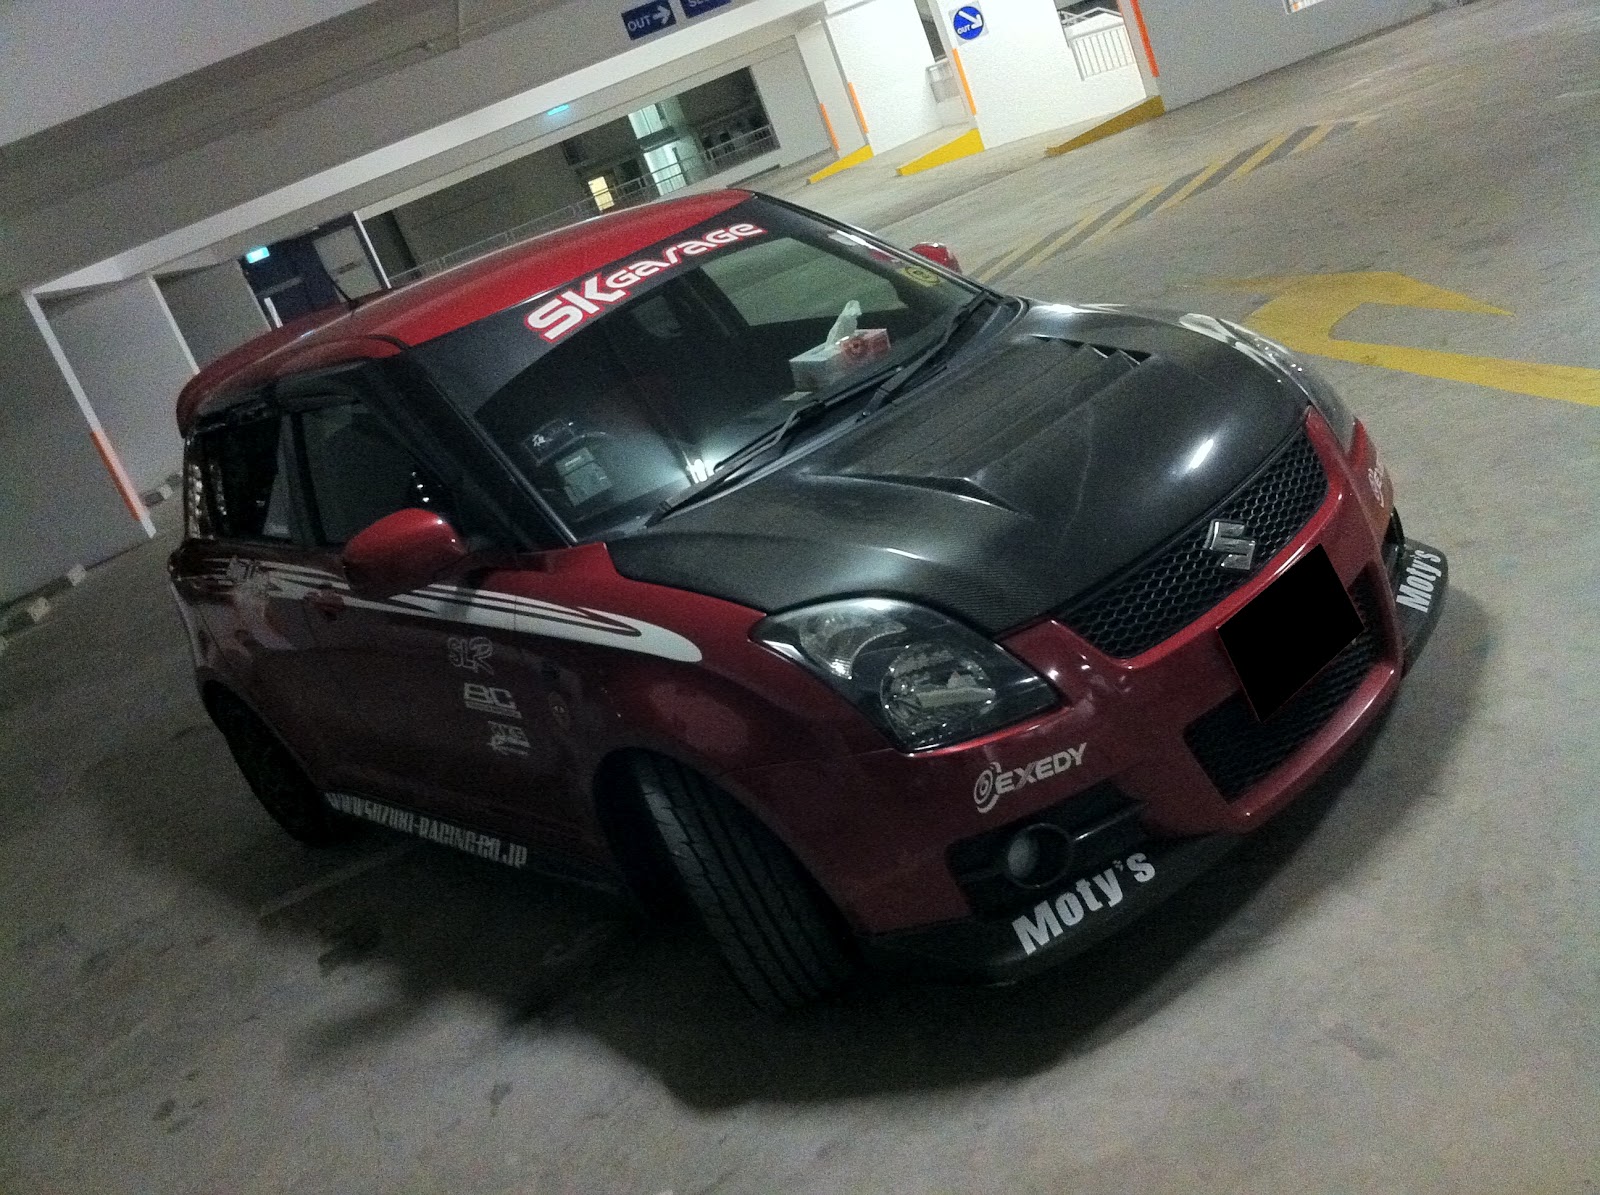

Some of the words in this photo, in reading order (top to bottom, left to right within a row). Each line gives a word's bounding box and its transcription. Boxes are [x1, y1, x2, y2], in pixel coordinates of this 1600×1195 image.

[627, 15, 653, 32] OUT
[957, 24, 971, 35] OUT
[1396, 550, 1442, 613] Moty's
[994, 742, 1087, 795] EXEDY
[1011, 852, 1156, 956] Moty's
